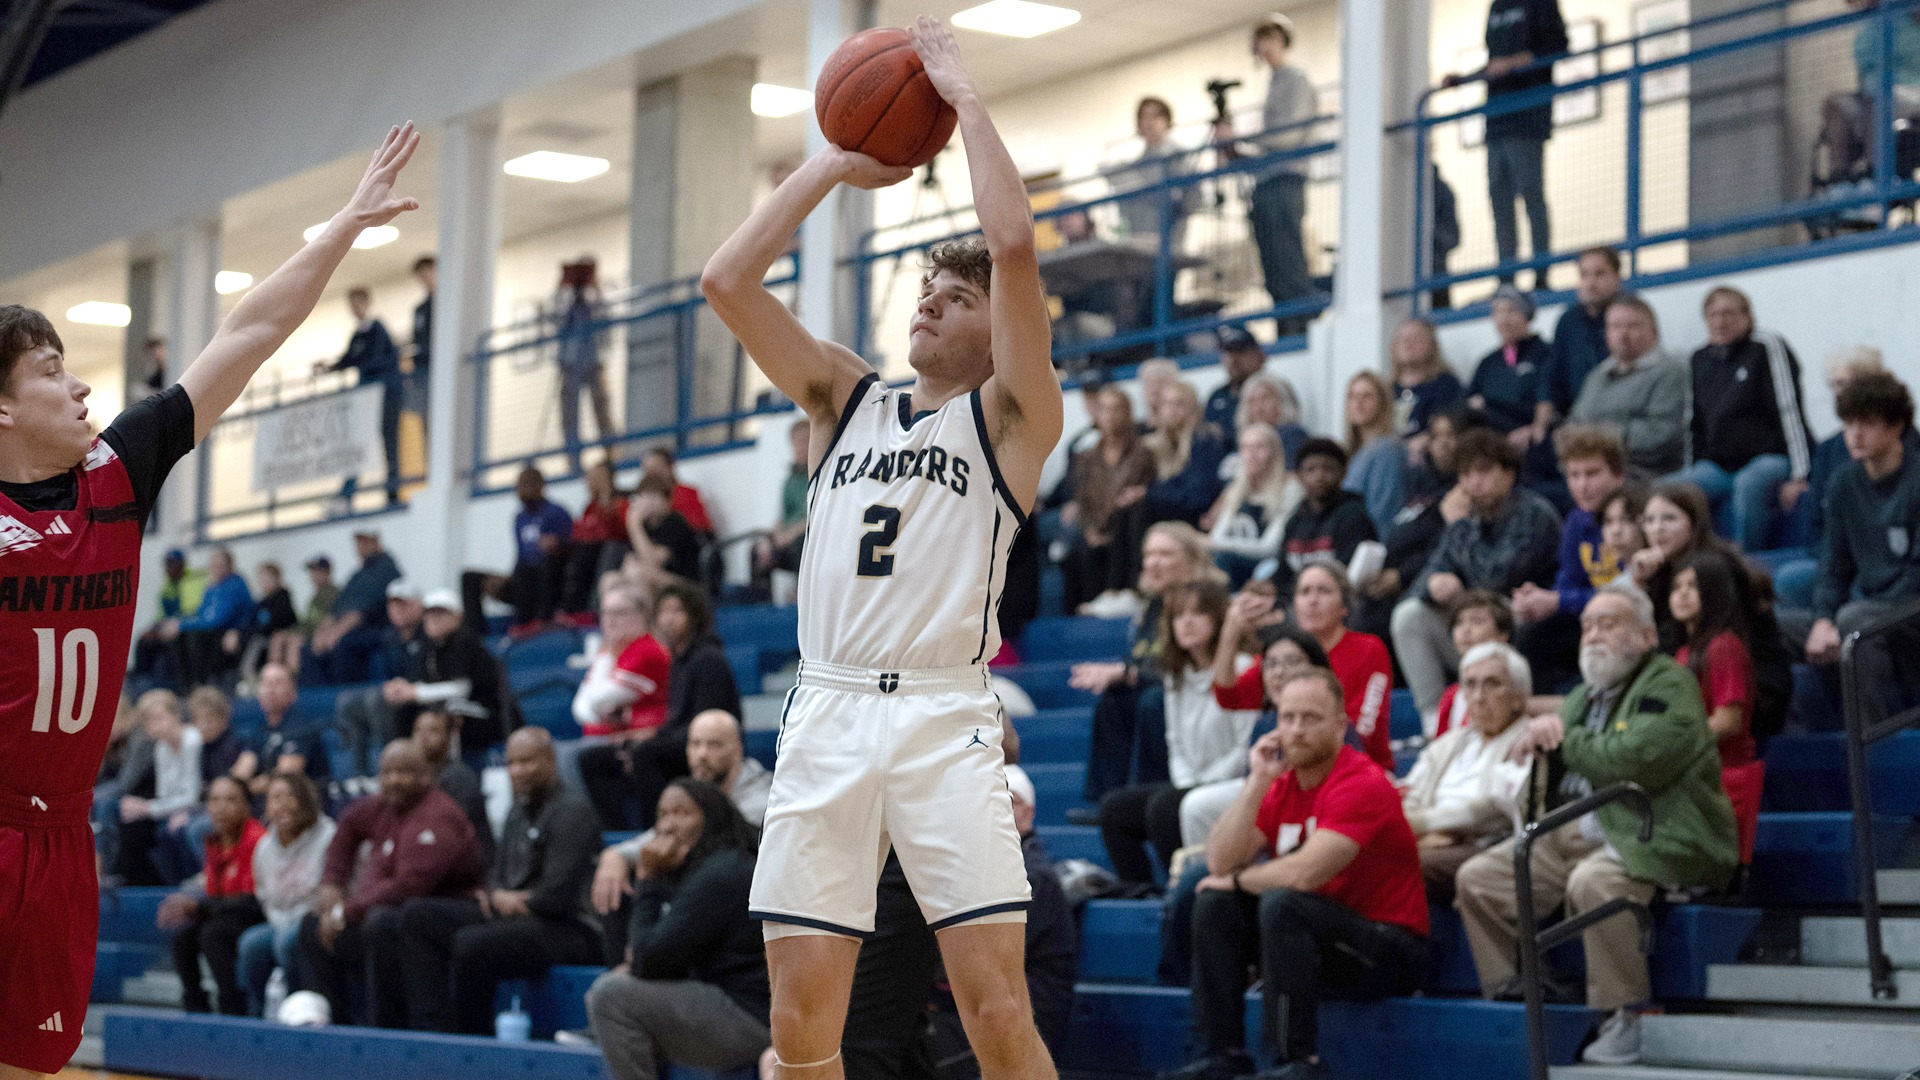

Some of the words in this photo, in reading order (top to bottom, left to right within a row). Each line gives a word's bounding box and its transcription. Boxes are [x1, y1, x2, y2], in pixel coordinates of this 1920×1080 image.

[831, 445, 970, 497] RANGERS
[856, 502, 903, 580] 2
[0, 565, 133, 612] ANTHERS
[31, 627, 100, 735] 10
